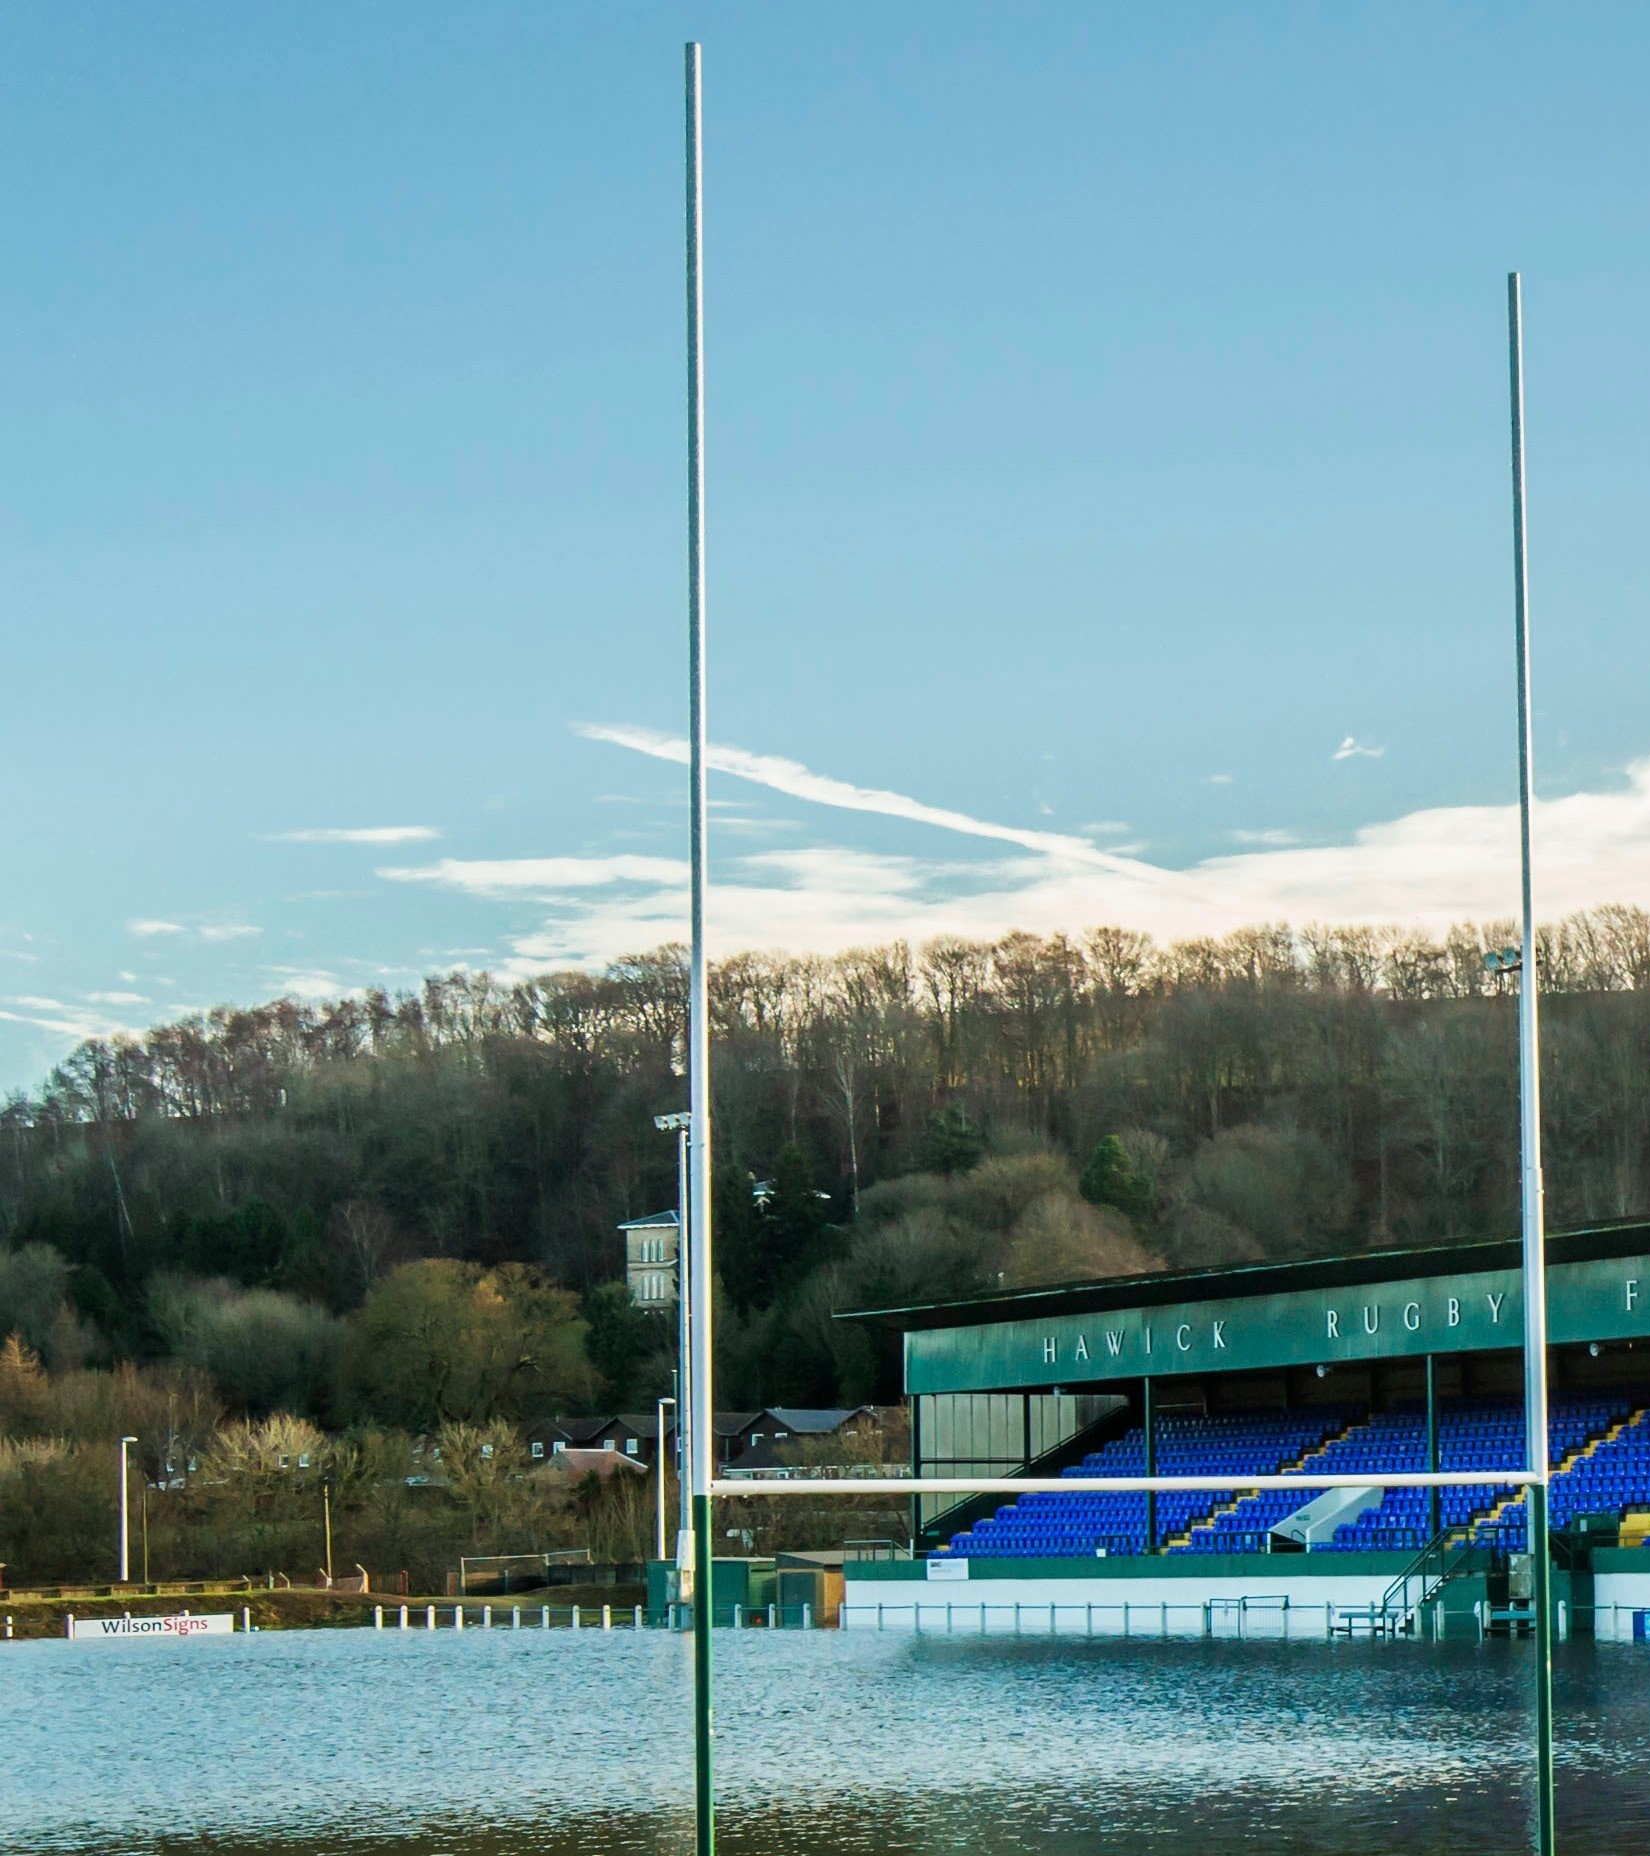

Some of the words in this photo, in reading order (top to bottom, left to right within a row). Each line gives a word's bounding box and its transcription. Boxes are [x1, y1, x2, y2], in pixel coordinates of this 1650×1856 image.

[1043, 1321, 1226, 1363] HAWICK
[1327, 1295, 1504, 1339] RUGBY
[101, 1618, 208, 1635] WilsonSigns
